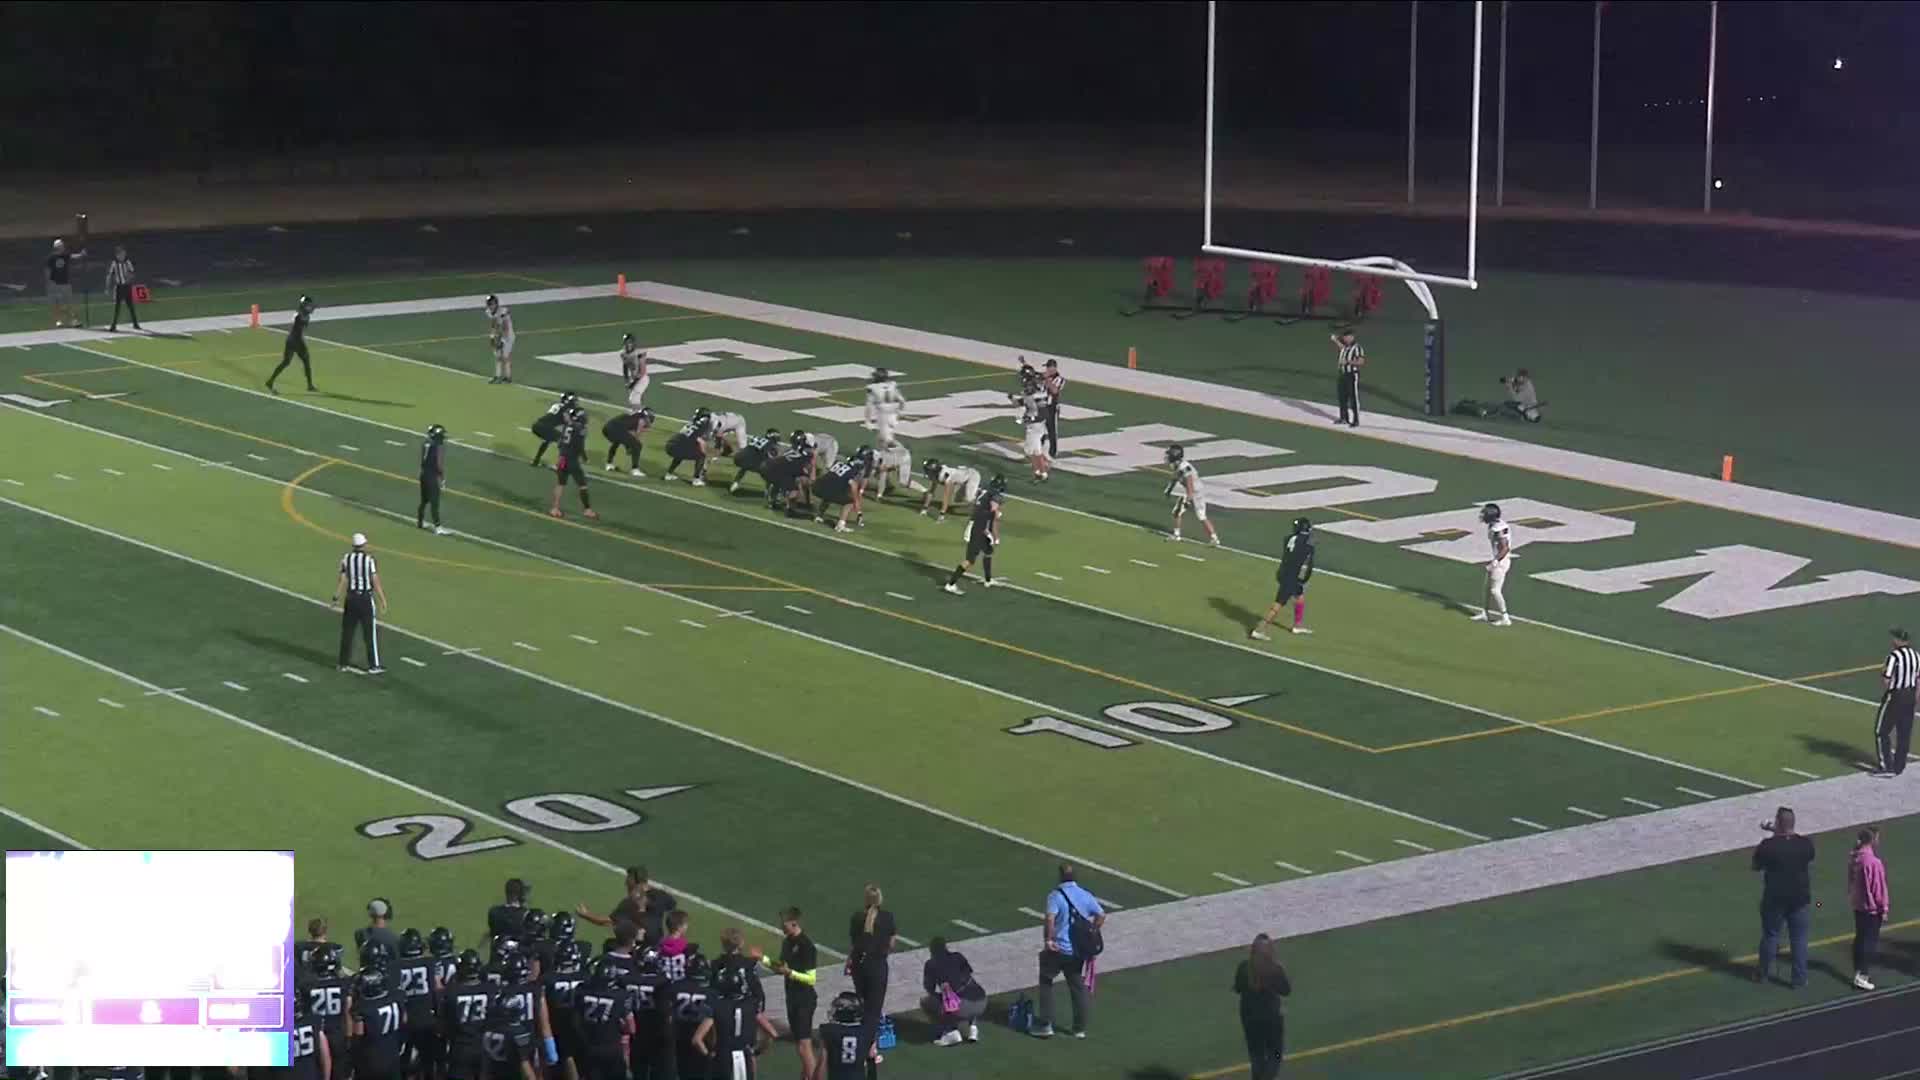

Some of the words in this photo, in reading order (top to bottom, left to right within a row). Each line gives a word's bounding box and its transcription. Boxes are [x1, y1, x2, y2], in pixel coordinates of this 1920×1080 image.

[829, 460, 852, 478] 68
[1004, 695, 1240, 749] 10
[358, 792, 646, 861] 20
[398, 966, 429, 996] 23
[310, 986, 342, 1016] 26
[456, 993, 489, 1023] 73
[582, 994, 615, 1022] 27
[377, 1001, 400, 1035] 71
[733, 1006, 744, 1038] 1
[841, 1035, 858, 1064] 8
